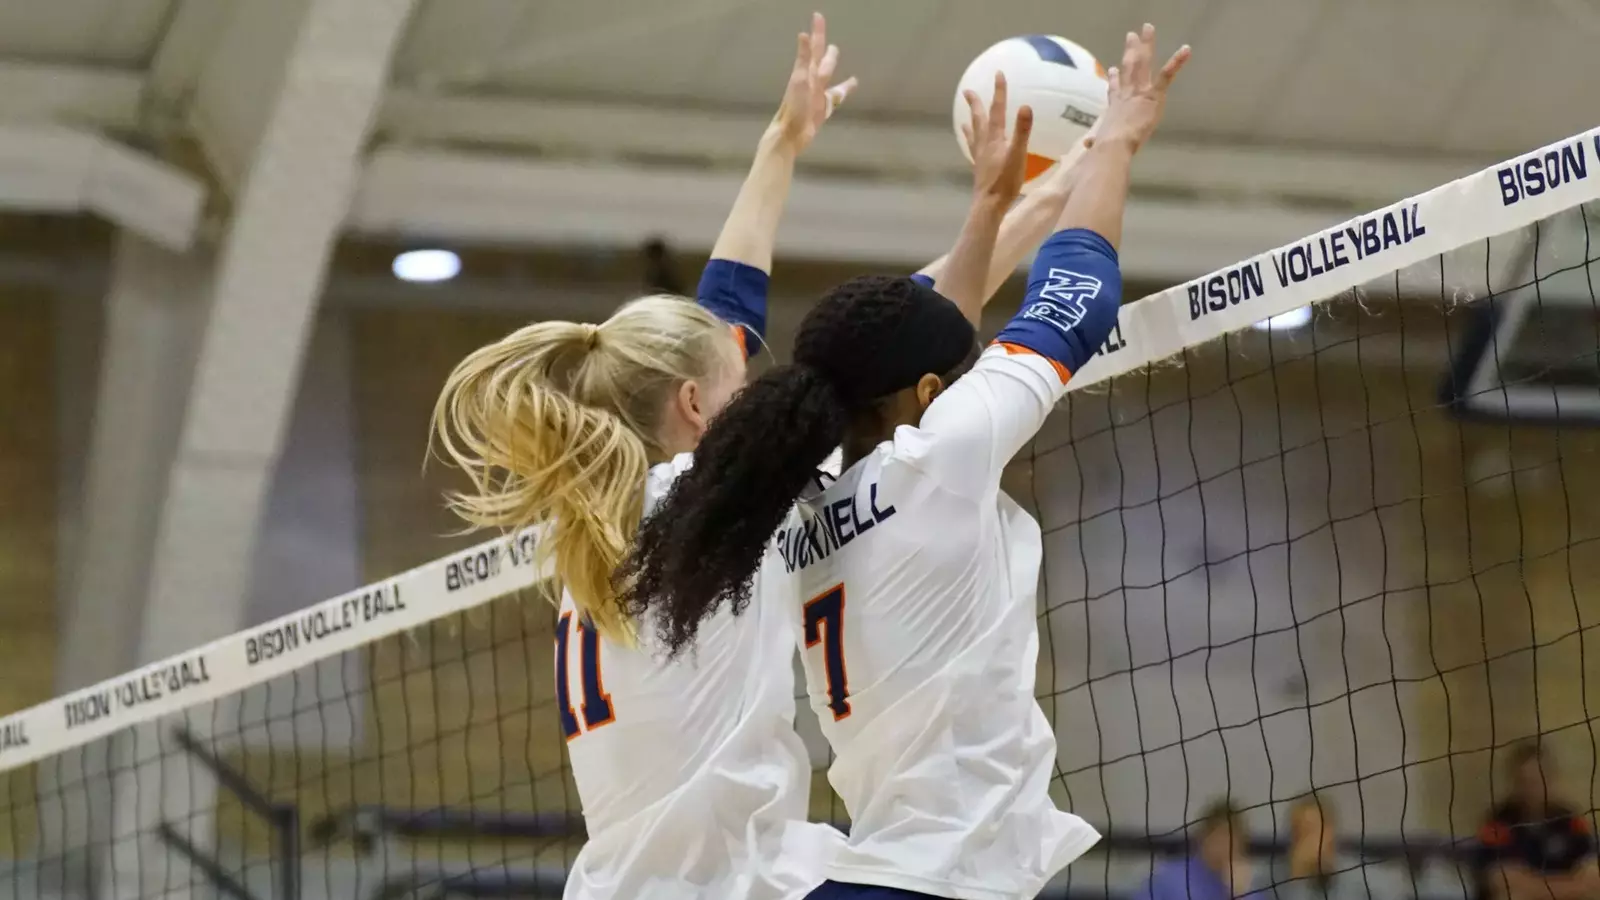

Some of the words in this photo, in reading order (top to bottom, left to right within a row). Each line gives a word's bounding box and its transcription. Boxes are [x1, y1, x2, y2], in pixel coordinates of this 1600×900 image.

[1497, 141, 1587, 206] BISON
[1188, 261, 1264, 321] BISON
[1272, 203, 1426, 288] VOLLEYBALL
[245, 621, 299, 665] BISON
[301, 583, 406, 644] VOLLEYBALL
[803, 581, 851, 723] 7
[554, 609, 616, 743] 11
[0, 719, 29, 748] ALL
